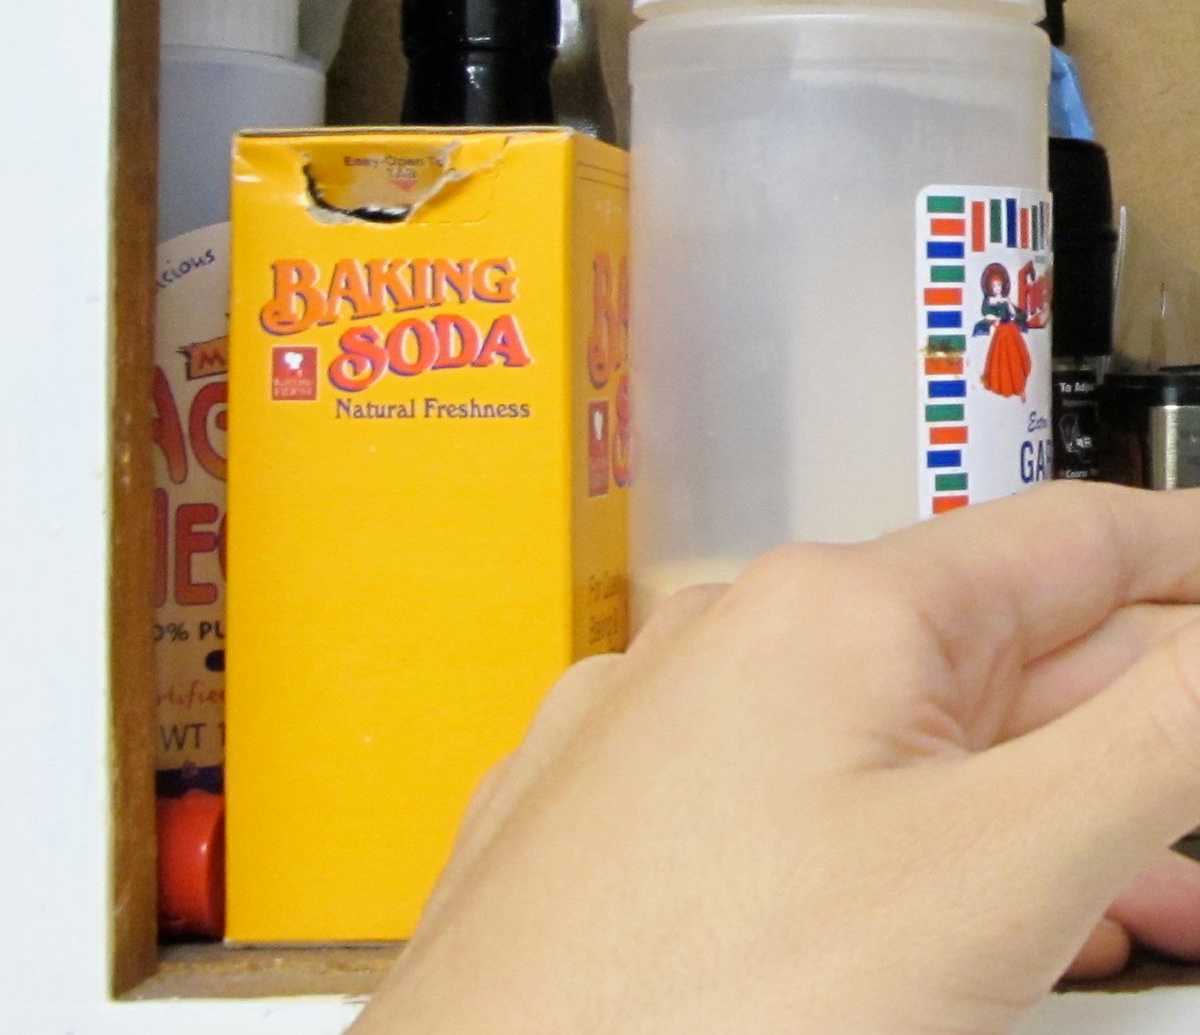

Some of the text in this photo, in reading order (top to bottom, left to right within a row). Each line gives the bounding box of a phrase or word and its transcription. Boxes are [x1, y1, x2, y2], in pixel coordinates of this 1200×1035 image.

[259, 256, 520, 337] BAKING
[328, 313, 535, 393] SODA
[335, 397, 531, 419] Natural Freshness
